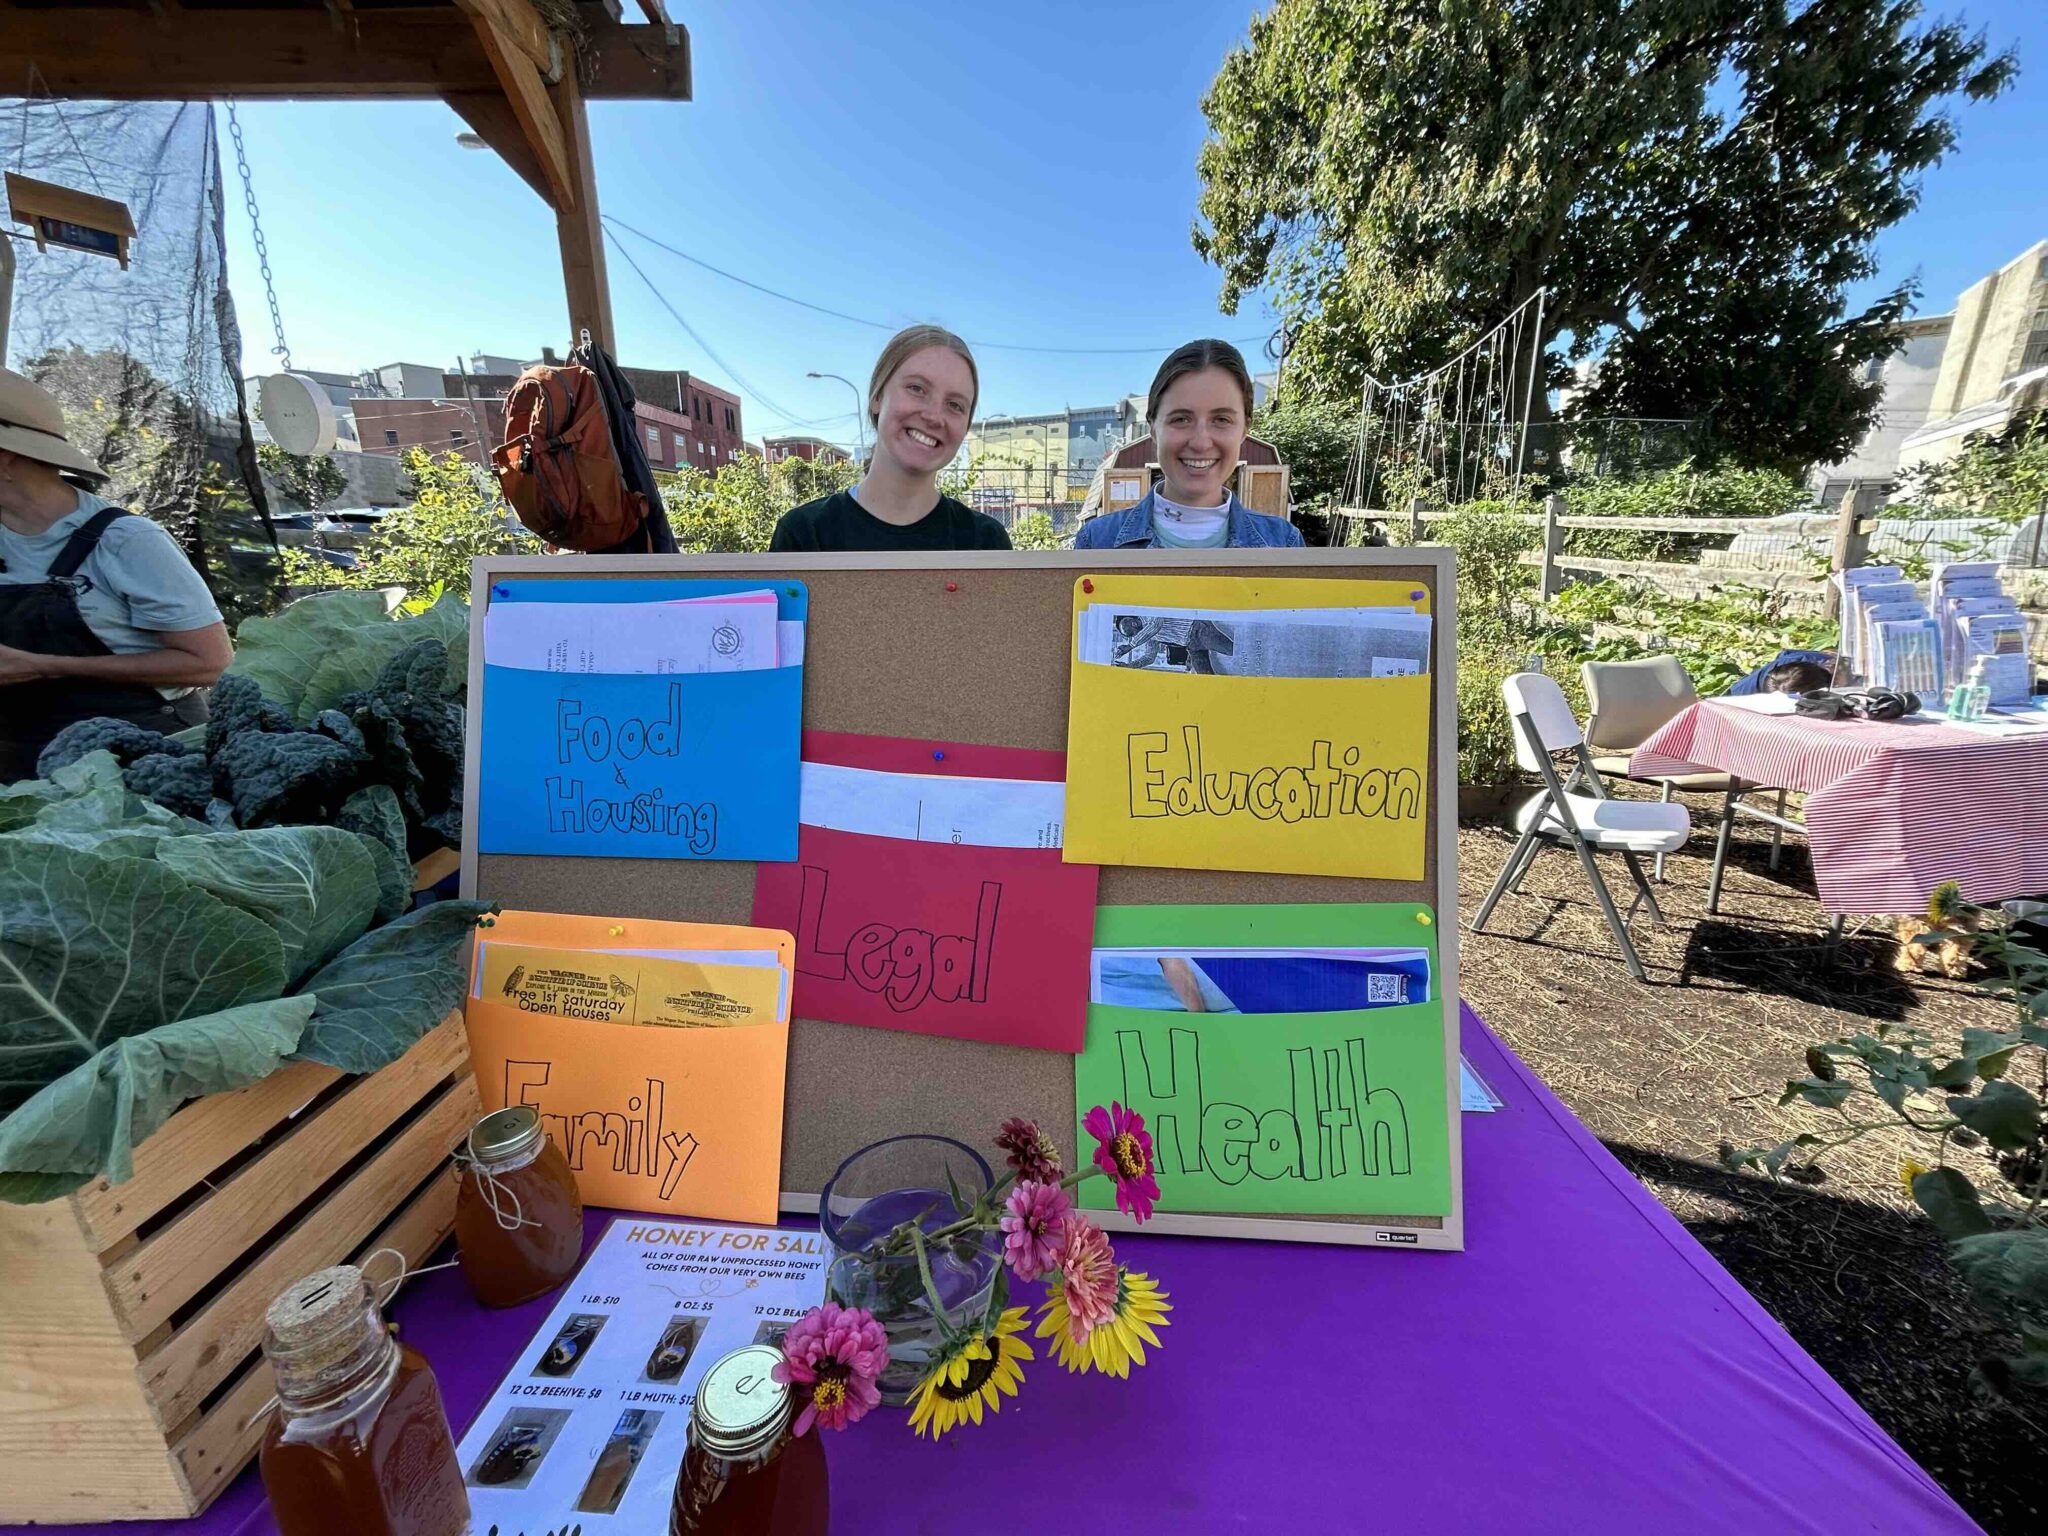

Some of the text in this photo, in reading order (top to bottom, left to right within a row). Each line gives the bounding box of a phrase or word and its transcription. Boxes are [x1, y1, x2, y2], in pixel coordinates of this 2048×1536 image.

[557, 683, 681, 764] Food
[1128, 726, 1422, 824] Education
[545, 776, 718, 855] Housing
[796, 866, 1002, 1012] Legal
[506, 988, 626, 1014] Free 1st Saturday
[518, 998, 610, 1020] Open Houses
[1116, 1028, 1412, 1185] Health
[505, 1059, 700, 1200] Family
[626, 1226, 716, 1246] HONEY
[719, 1232, 769, 1250] FOR
[646, 1263, 806, 1280] COMES FROM OUR VERY OWN BEES
[660, 1252, 674, 1260] OF
[676, 1253, 696, 1262] OUR
[698, 1254, 720, 1262] RAW
[721, 1256, 786, 1268] UNPROCESSED
[788, 1261, 821, 1270] HONEY
[580, 1296, 620, 1305] 1 LB: $10
[674, 1301, 714, 1311] 8 OZ: $5
[754, 1306, 764, 1314] 12
[766, 1308, 782, 1316] OZ
[510, 1385, 602, 1398] 12 OZ BEEHIVE: $8
[620, 1390, 696, 1406] 1 LB MUTH: $12
